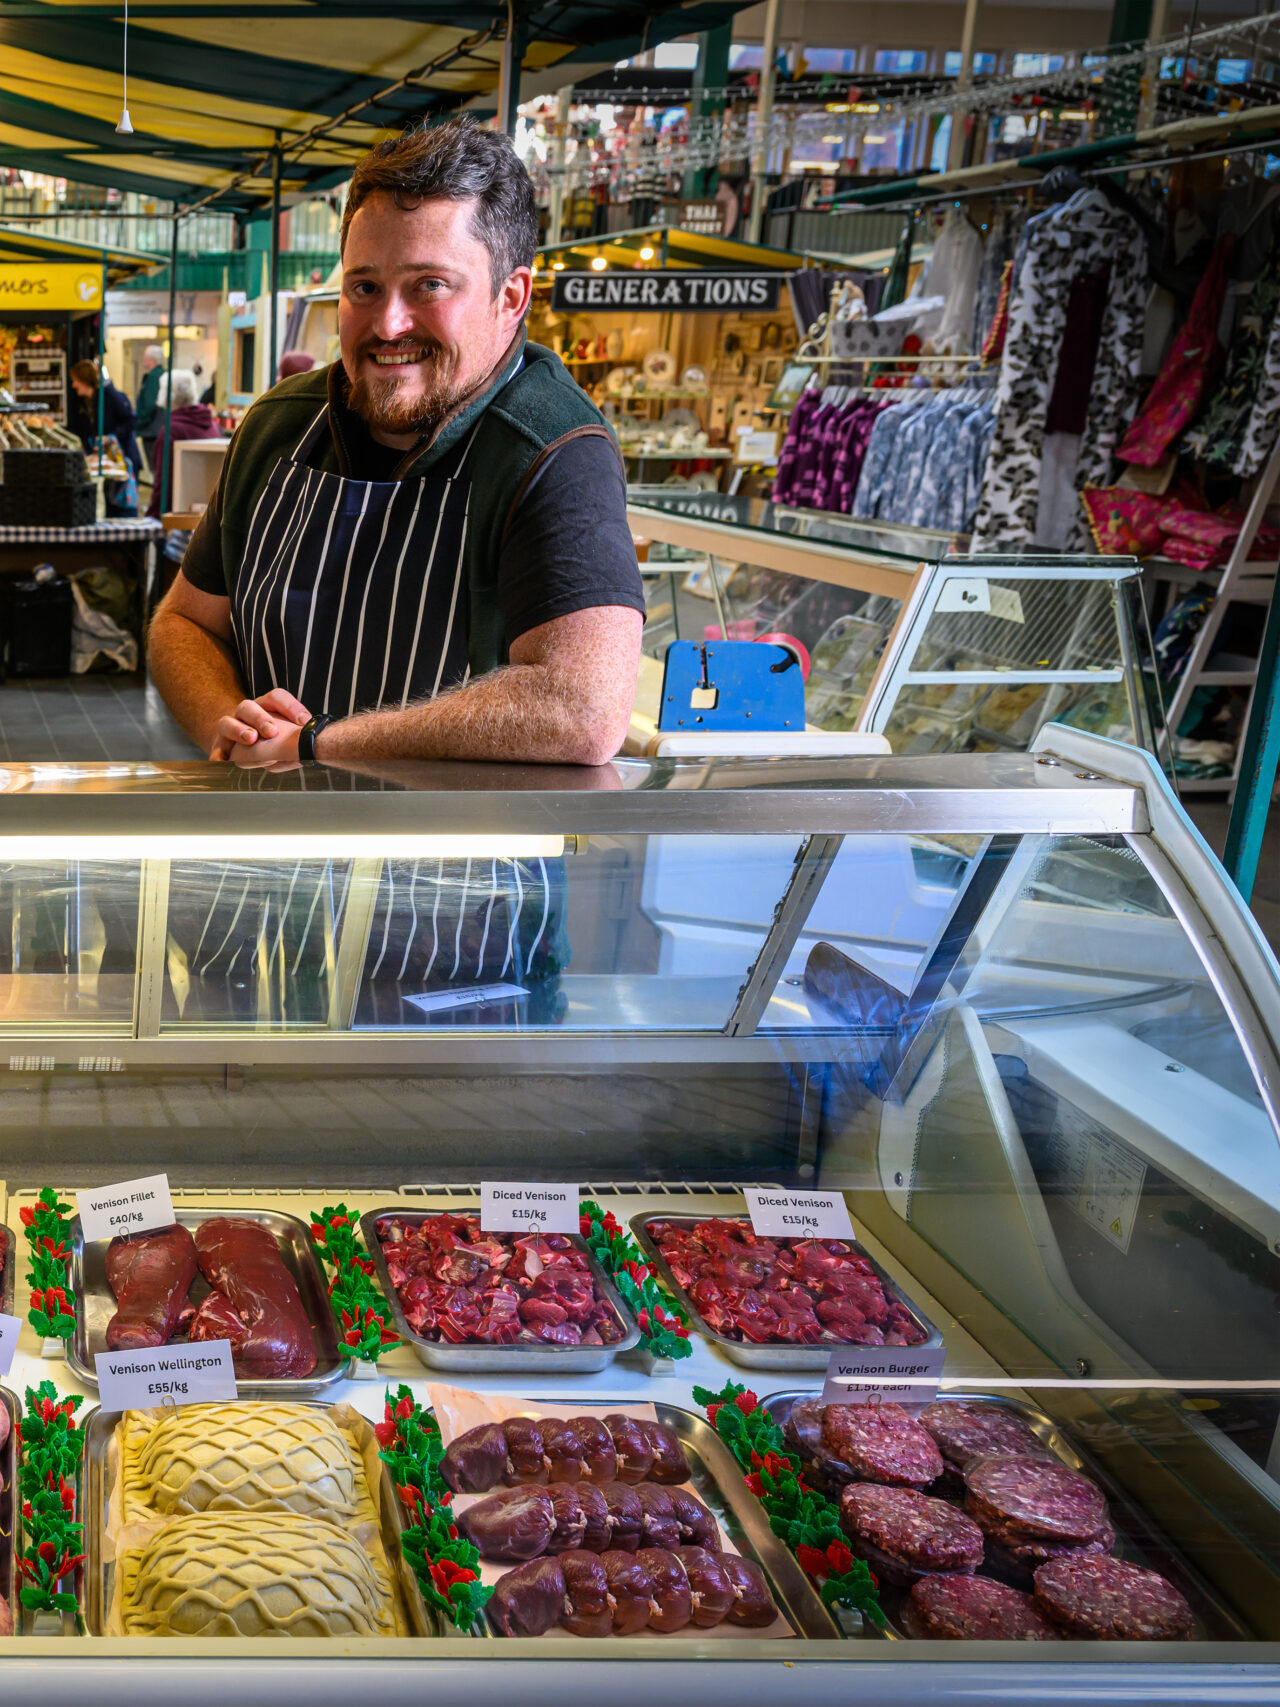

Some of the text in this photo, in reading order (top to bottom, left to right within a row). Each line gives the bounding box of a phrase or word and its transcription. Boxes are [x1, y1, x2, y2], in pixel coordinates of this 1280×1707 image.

[685, 205, 717, 220] THAI
[564, 277, 768, 305] GENERATIONS
[90, 1191, 155, 1211] Venison Fillet
[493, 1190, 566, 1200] Diced Venison
[758, 1196, 833, 1208] Diced Venison
[110, 1212, 144, 1226] £40/kg
[512, 1210, 546, 1220] £15/kg
[782, 1215, 819, 1227] £15/kg
[109, 1357, 222, 1375] Venison Wellington
[838, 1364, 930, 1375] Venison Burger
[148, 1382, 188, 1394] £55/kg
